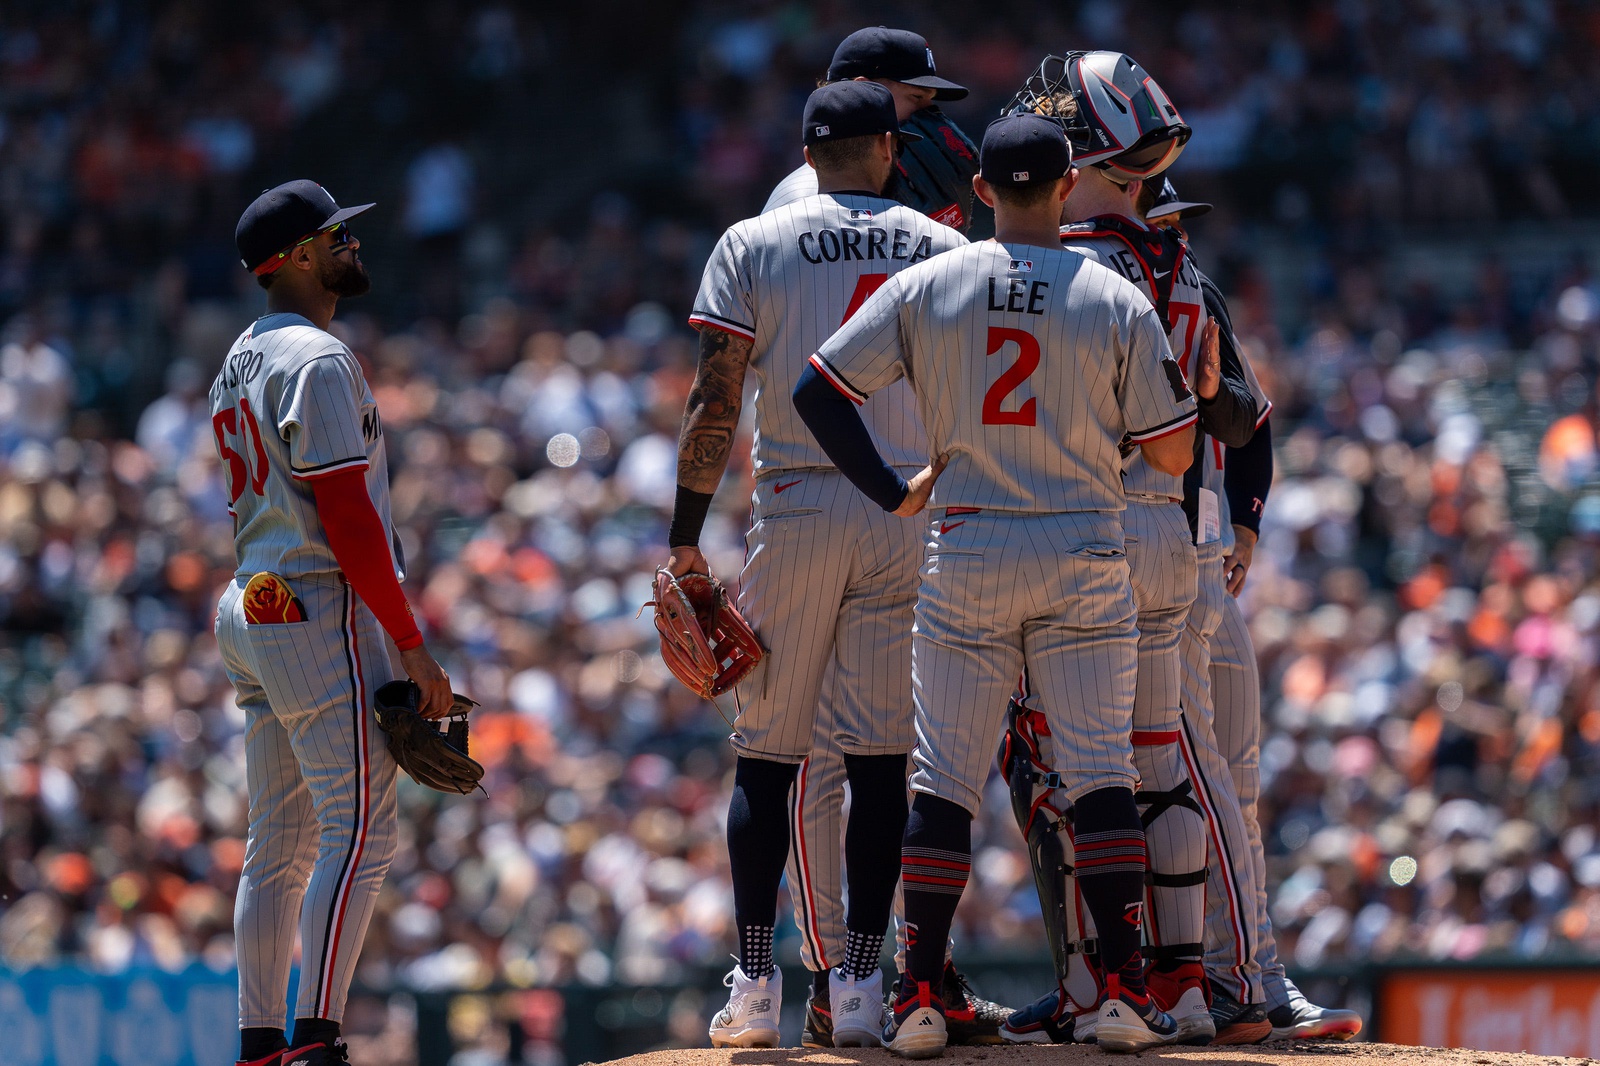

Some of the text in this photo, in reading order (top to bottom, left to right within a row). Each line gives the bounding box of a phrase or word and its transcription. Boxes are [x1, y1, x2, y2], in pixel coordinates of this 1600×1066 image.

[798, 227, 932, 264] CORREA
[987, 276, 1049, 316] LEE
[981, 326, 1041, 427] 2
[212, 398, 270, 505] 50
